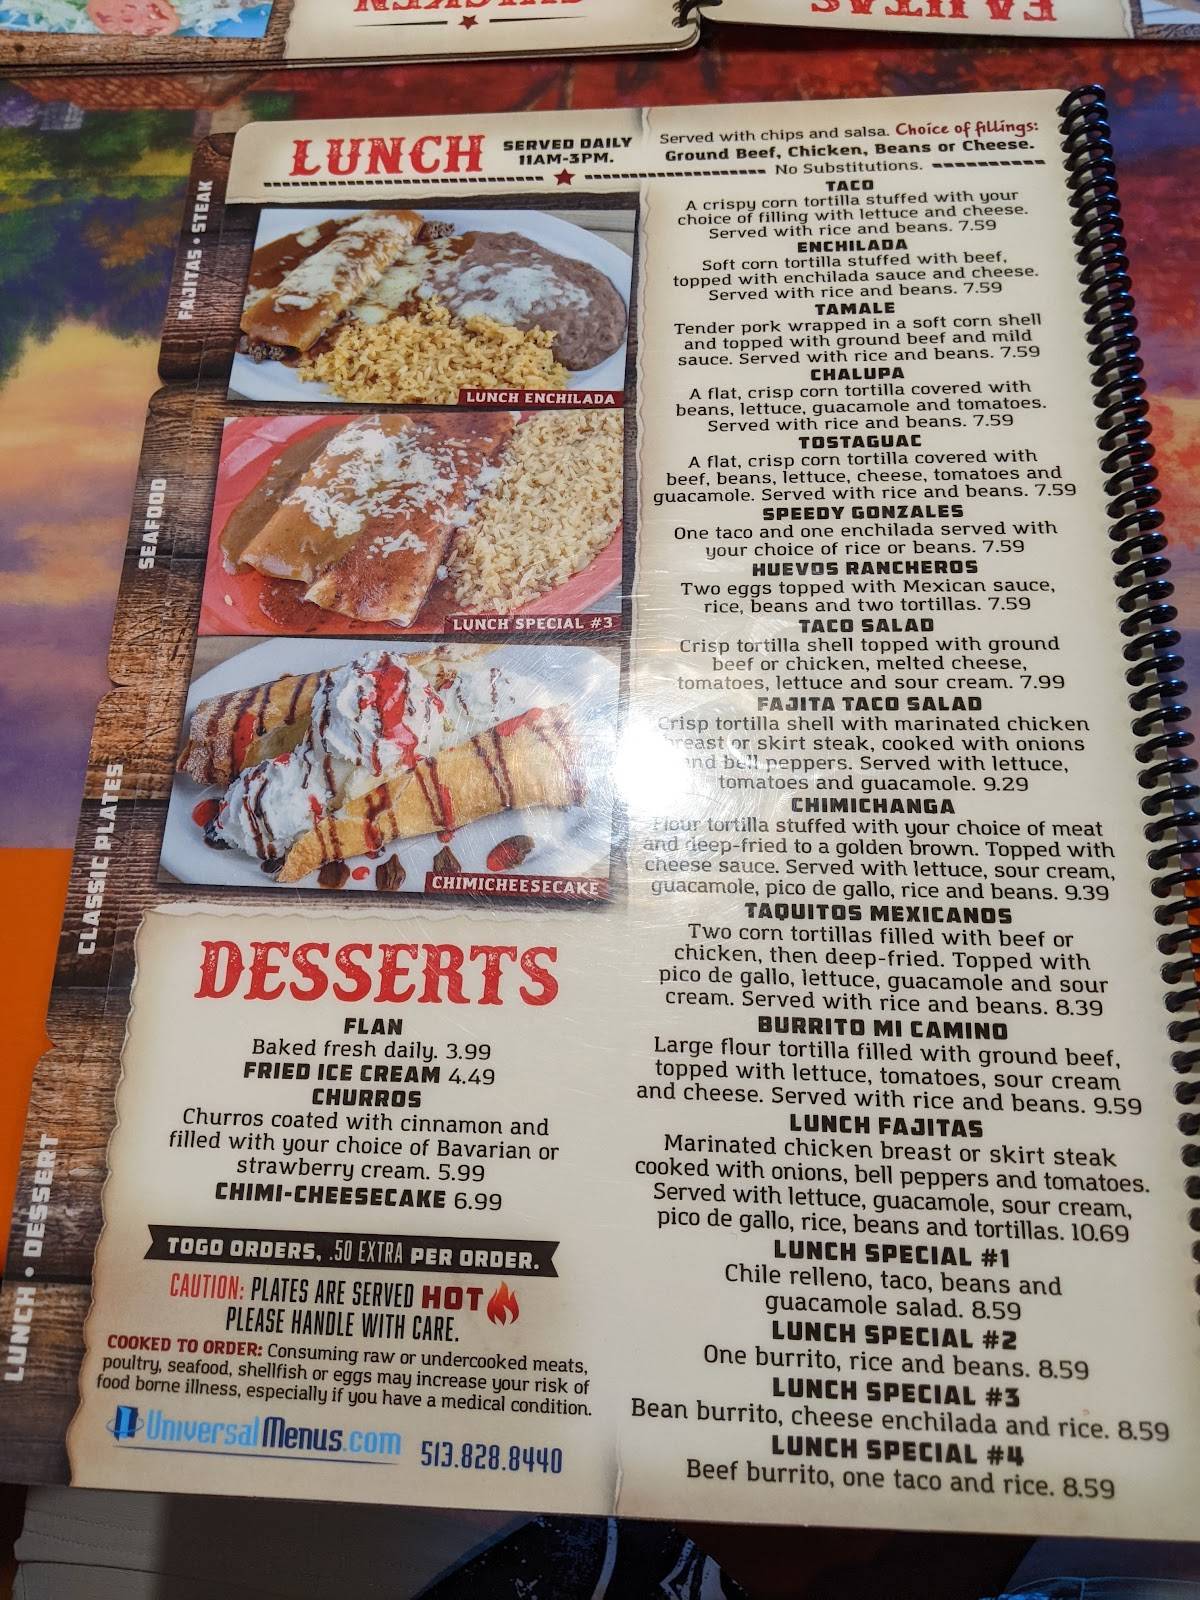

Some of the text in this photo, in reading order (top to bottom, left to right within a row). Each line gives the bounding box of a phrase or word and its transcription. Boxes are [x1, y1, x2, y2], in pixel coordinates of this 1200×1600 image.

[503, 136, 633, 151] SERVED DAILY
[660, 120, 1039, 144] Served with chips and salsa. Choice of fillings:
[289, 135, 485, 176] LUNCH
[519, 152, 614, 165] 11AM-3PM.
[665, 139, 1035, 161] Ground Beef, Chicken, Beans or Cheese.
[775, 161, 923, 175] No Substitutions.
[825, 179, 874, 192] TACO
[685, 190, 1019, 212] A crispy corn tortilla stuffed with your
[177, 180, 213, 320] FAJITAS STEAK
[797, 238, 908, 253] ENCHILADA
[709, 281, 1002, 301] Served with rice and beans. 7.59
[814, 302, 895, 315] TAMALE
[810, 367, 905, 381] CHALUPA
[466, 391, 616, 405] LUNCH ENCHILADA
[798, 434, 922, 449] TOSTAGUAC
[138, 478, 167, 570] SEAFOOD
[762, 504, 964, 521] SPEEDY GONZALES
[752, 560, 978, 577] HUEVOS RANCHEROS
[704, 596, 1031, 615] rice, beans and two tortillas. 7.59
[453, 616, 613, 630] LUNCH SPECIAL #3
[798, 618, 934, 633] TACO SALAD
[757, 696, 982, 711] FAJITA TACO SALAD
[791, 797, 956, 814] CHIMICHANGA
[77, 762, 125, 956] CLASSIC PLATES
[432, 875, 599, 895] CHIMICHEESECAKE
[744, 902, 1012, 924] TAQUITOS MEXICANOS
[194, 940, 559, 1006] DESSERTS
[665, 990, 1103, 1017] cream. Served with rice and beans. 8.39
[344, 1017, 403, 1035] FLAN
[758, 1016, 1008, 1040] BURRITO MI CAMINO
[252, 1038, 491, 1063] Baked fresh daily. 3.99
[243, 1061, 495, 1086] FRIED ICE CREAM 4.49
[312, 1088, 421, 1108] CHURROS
[183, 1107, 549, 1136] Churros coated with cinnamon and
[790, 1113, 983, 1138] LUNCH FAJITAS
[169, 1130, 560, 1161] filled with your choice of Bavarian or
[237, 1157, 485, 1182] strawberry cream. 5.99
[215, 1182, 502, 1211] CHIMI-CHEESECAKE 6.99
[4, 1134, 61, 1383] LUNCH DESSERT
[168, 1237, 539, 1269] TOGO ORDERS, .50 EXTRA PER ORDER.
[774, 1239, 1009, 1268] LUNCH SPECIAL #1
[170, 1273, 483, 1311] CAUTION: PLATES ARE SERVED HOT
[765, 1294, 1021, 1321] guacamole salad. 8.59
[225, 1306, 459, 1342] PLEASE HANDLE WITH CARE.
[772, 1320, 1017, 1350] LUNCH SPECIAL #2
[107, 1334, 588, 1376] COOKED TO ORDER: Consuming raw or undercooked meats,
[772, 1377, 1020, 1408] LUNCH SPECIAL #3
[146, 1410, 401, 1455] UniversalMenus.com
[421, 1440, 563, 1474] 513.828.8440
[772, 1435, 1024, 1467] LUNCH SPECIAL #4
